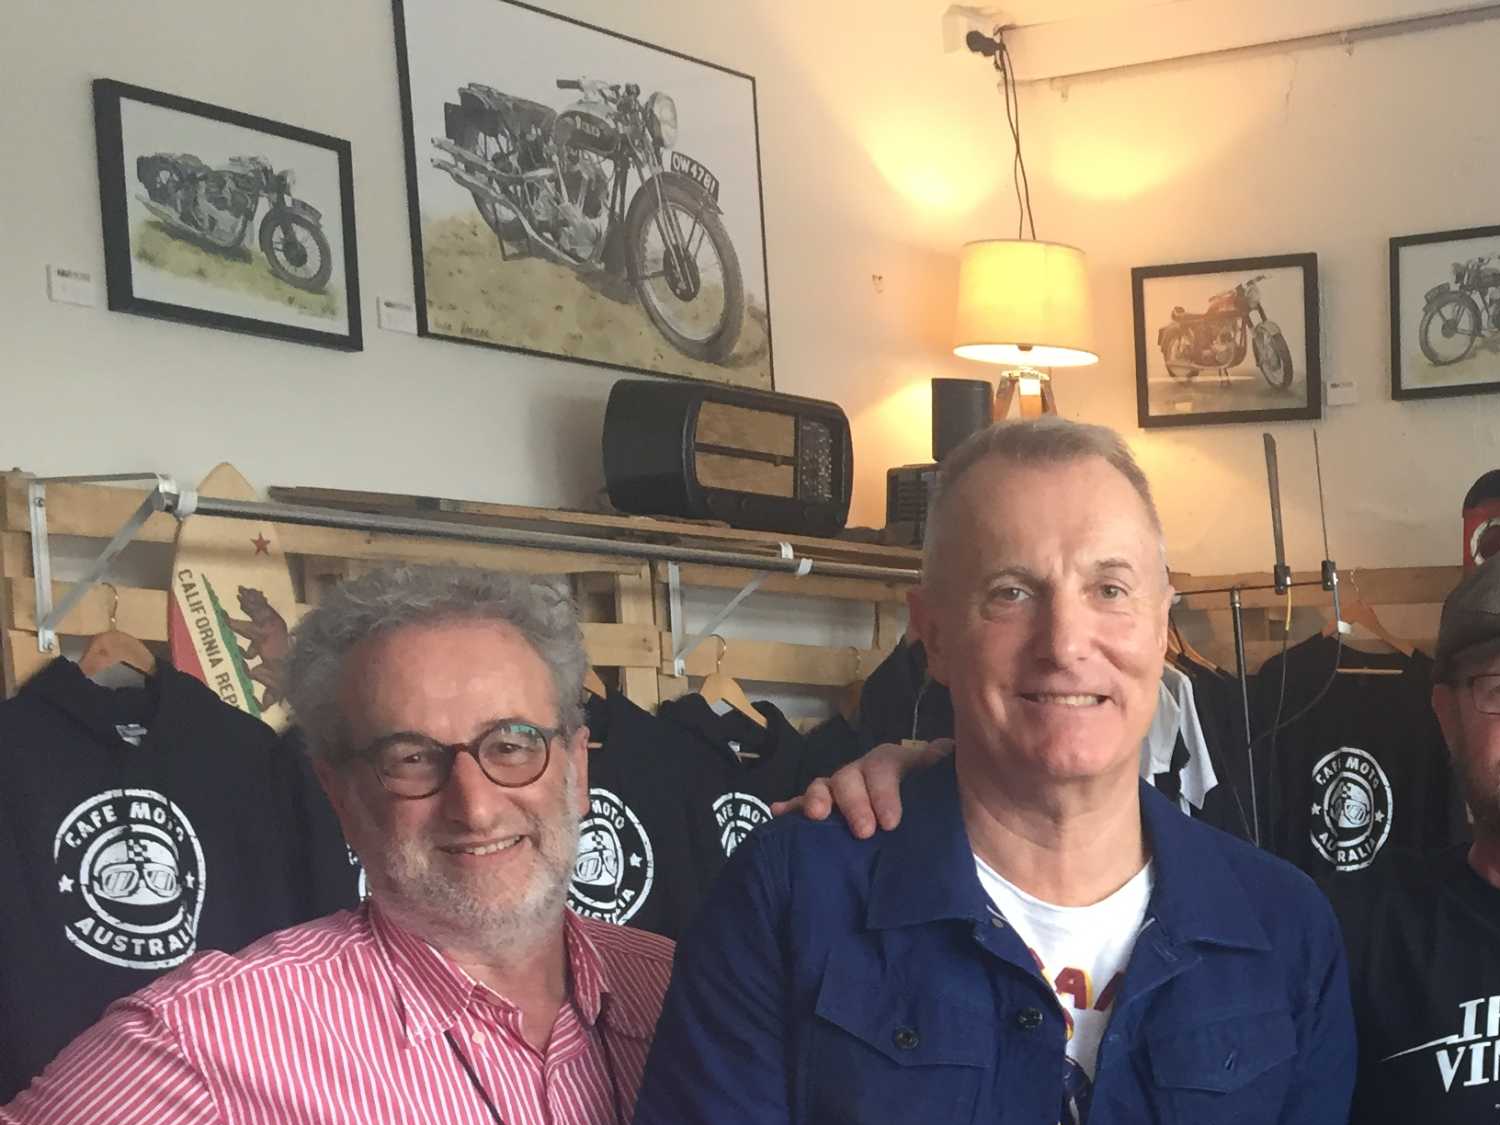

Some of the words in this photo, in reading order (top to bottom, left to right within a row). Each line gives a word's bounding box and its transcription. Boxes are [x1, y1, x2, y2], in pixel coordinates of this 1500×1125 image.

[178, 569, 224, 668] CALIFORNIA
[215, 671, 240, 710] REP
[64, 804, 117, 848] CAFE
[739, 803, 768, 824] MOT
